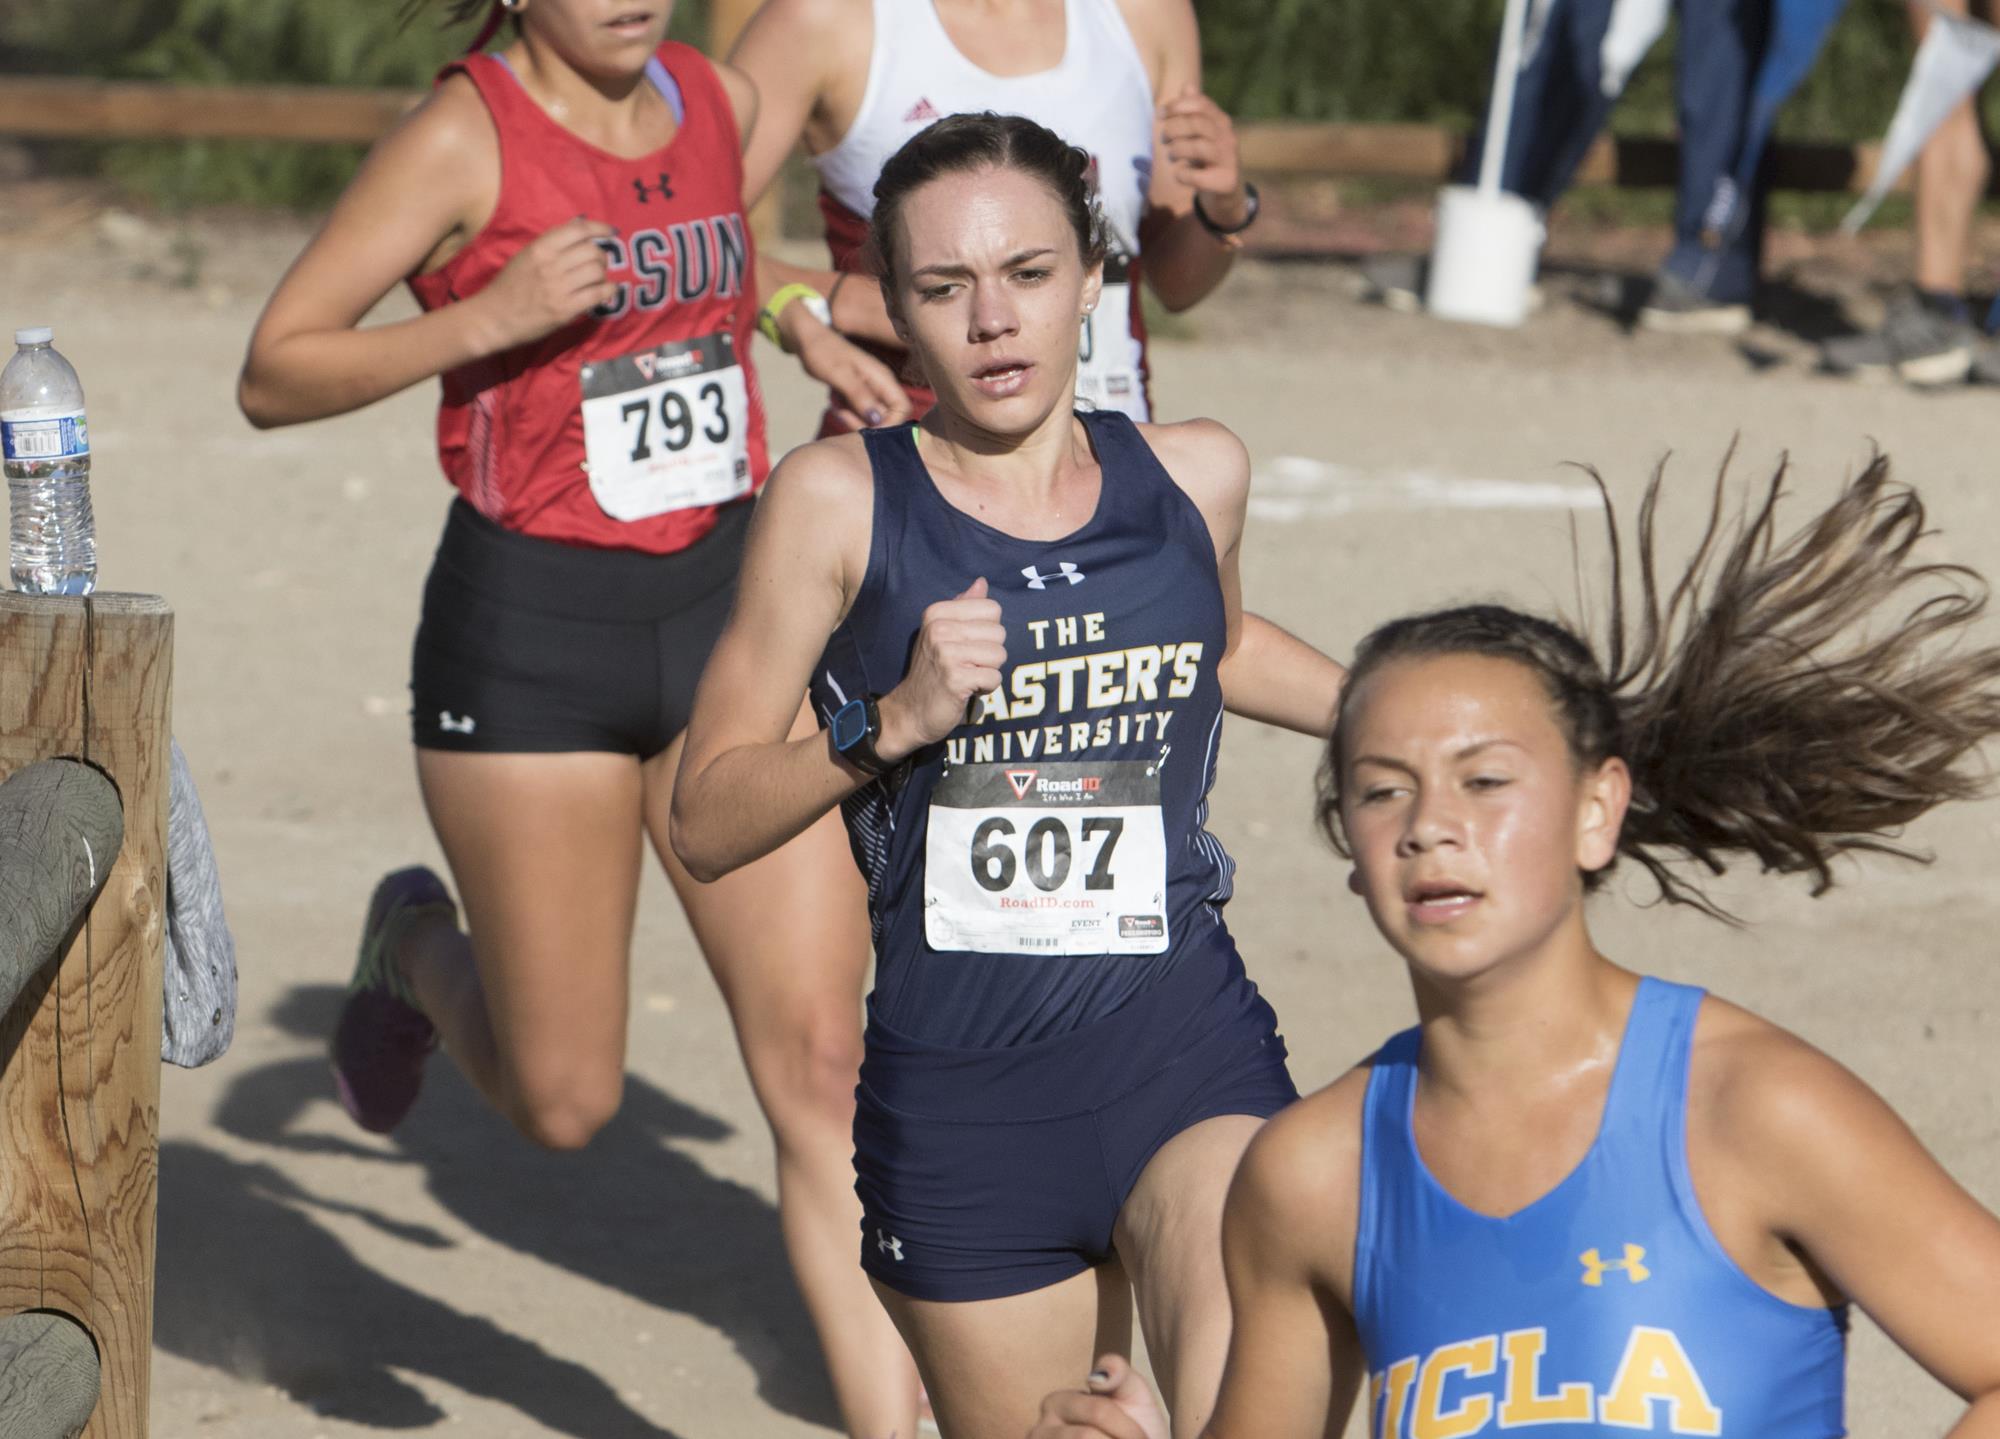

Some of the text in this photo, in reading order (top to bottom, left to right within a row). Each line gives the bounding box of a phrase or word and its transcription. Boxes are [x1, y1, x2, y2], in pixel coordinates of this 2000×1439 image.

[589, 212, 747, 319] CSUN
[621, 382, 730, 462] 793
[1028, 612, 1106, 650] THE
[966, 642, 1204, 725] ASTER'S
[946, 710, 1174, 765] UNIVERSITY
[971, 816, 1124, 892] 607
[1000, 897, 1095, 909] RoadID.com
[1071, 919, 1101, 928] EVENT
